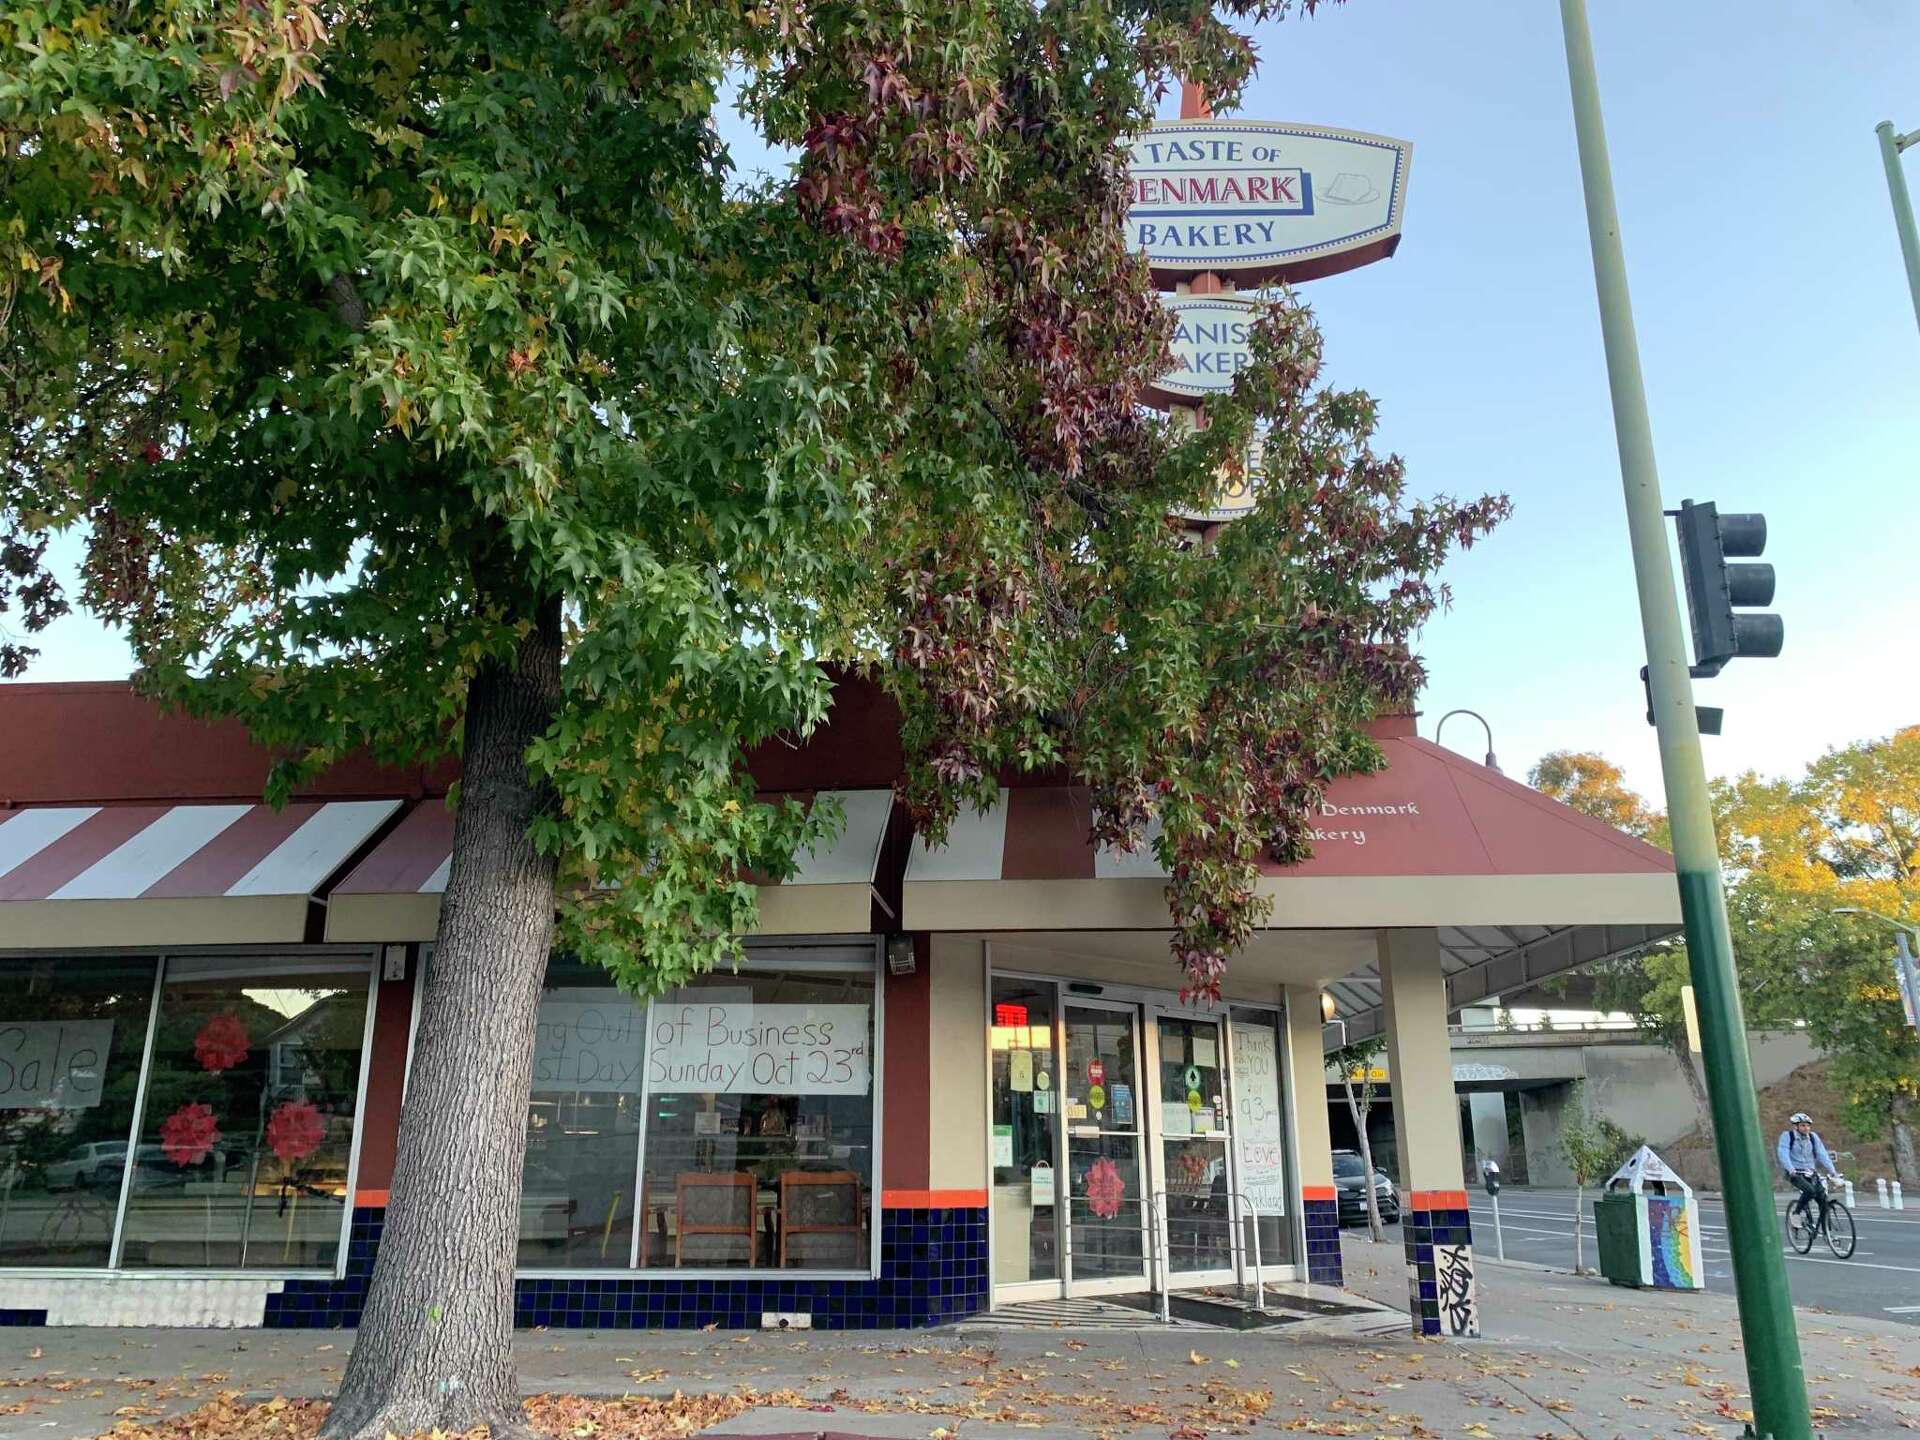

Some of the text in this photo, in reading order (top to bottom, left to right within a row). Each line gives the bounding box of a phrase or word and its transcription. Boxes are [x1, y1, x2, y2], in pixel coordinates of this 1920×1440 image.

[1144, 139, 1244, 163] TASTE
[1252, 147, 1282, 163] OF
[1138, 221, 1275, 247] BAKERY
[1173, 322, 1250, 345] ANIS
[1179, 352, 1249, 374] AKER
[1322, 801, 1420, 817] Denmark
[1304, 827, 1366, 845] akery
[576, 1007, 644, 1045] Out
[656, 1007, 695, 1046] of
[706, 1007, 834, 1047] Business
[0, 1025, 98, 1094] Sale
[576, 1050, 642, 1090] Day
[650, 1048, 745, 1092] Sunday
[752, 1050, 800, 1085] Oct
